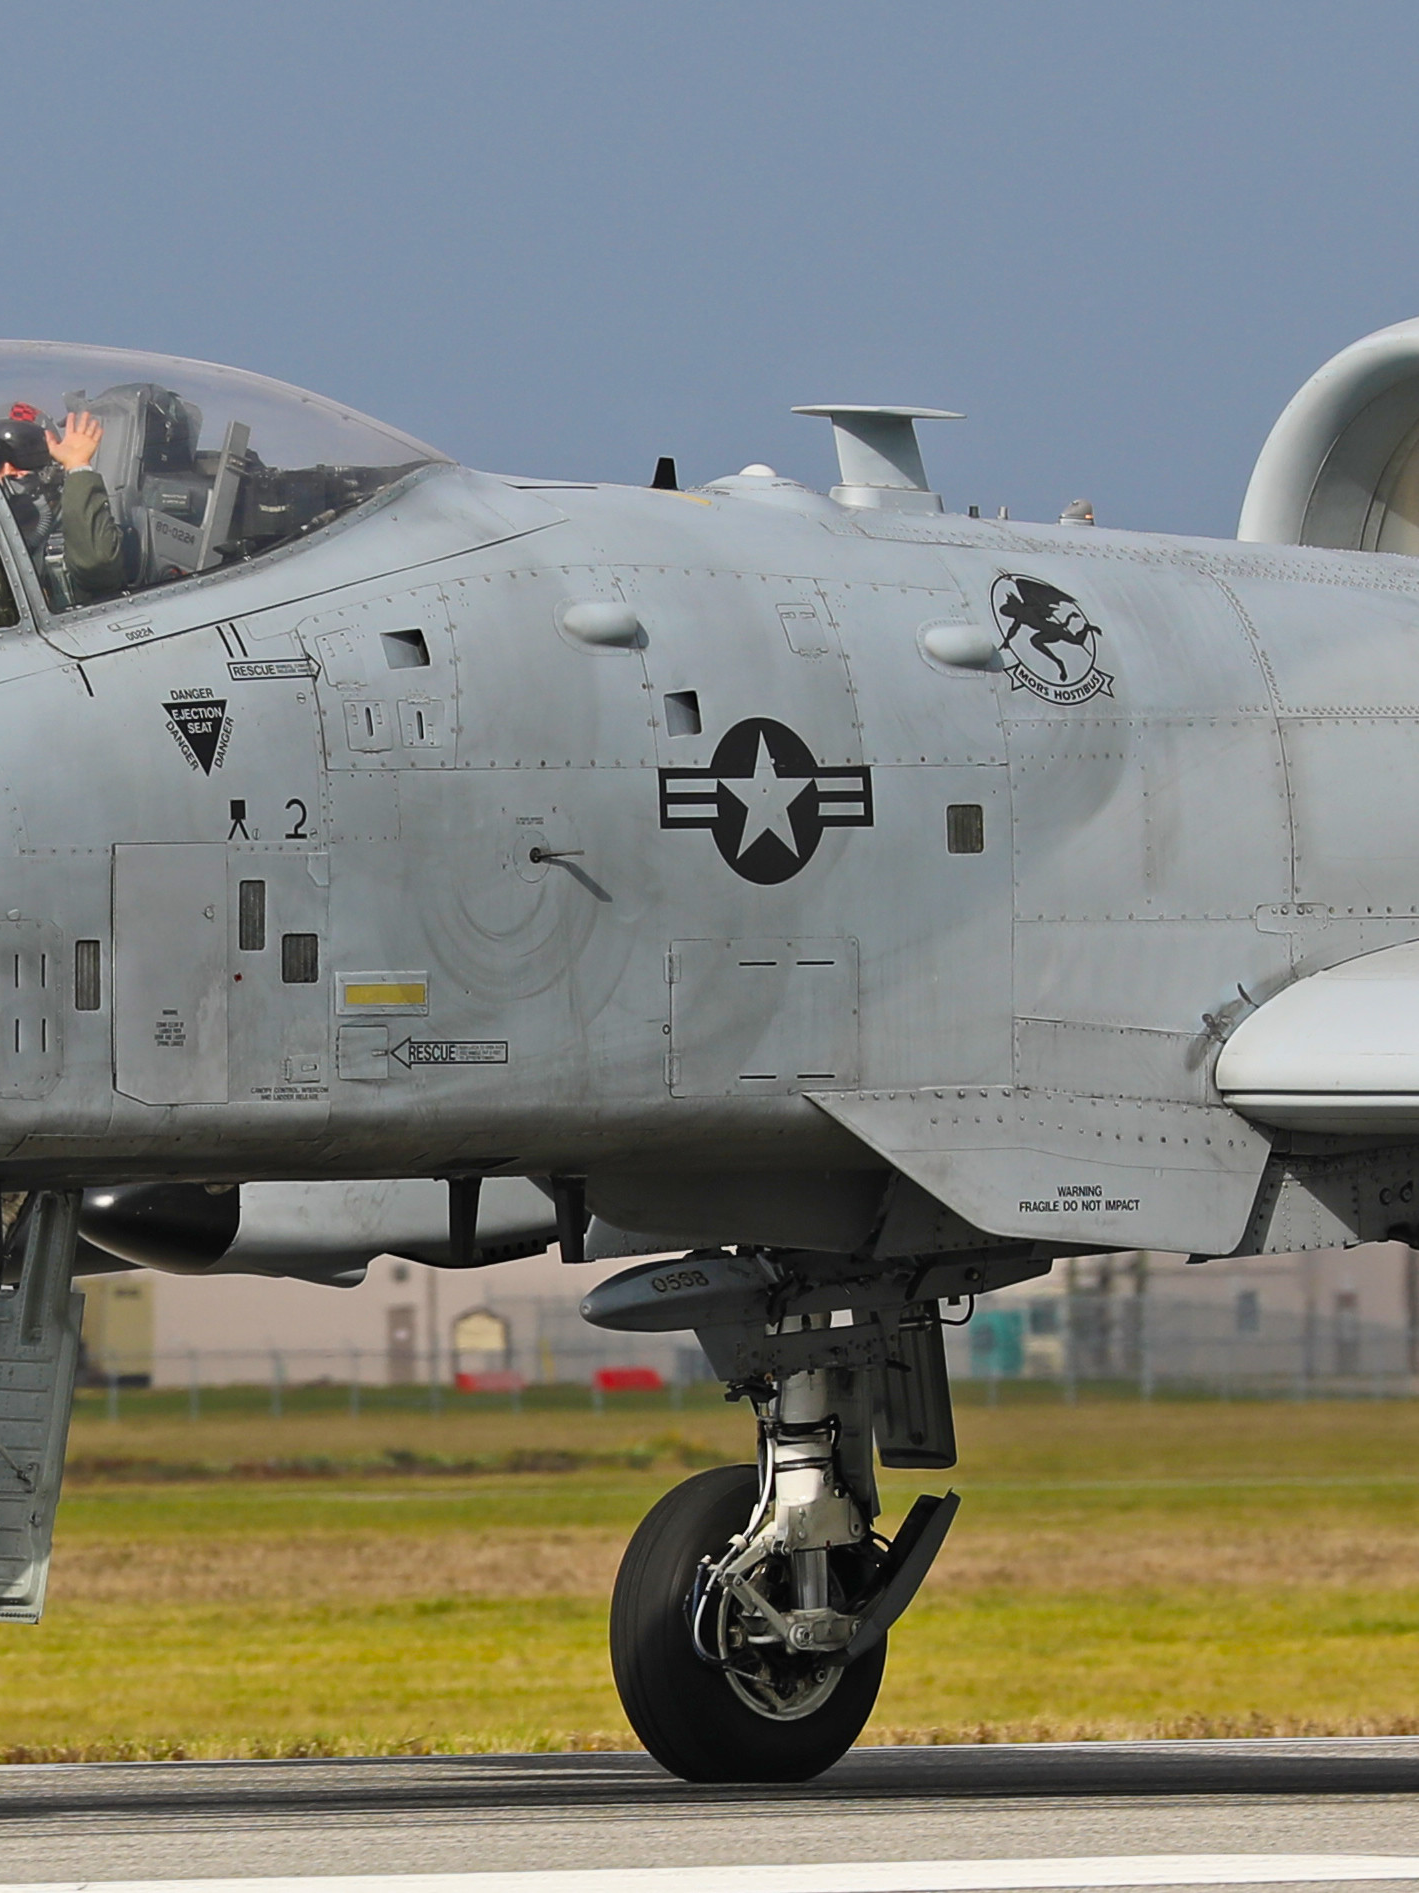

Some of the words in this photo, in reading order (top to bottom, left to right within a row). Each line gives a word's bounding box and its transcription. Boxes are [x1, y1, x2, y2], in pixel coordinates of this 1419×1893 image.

[155, 520, 196, 545] 80-0224
[232, 664, 277, 677] RESCUE
[1018, 669, 1050, 697] MORS
[1054, 674, 1100, 701] HOSTIBUS
[170, 687, 215, 701] DANGER
[171, 706, 223, 721] EJECTION
[187, 721, 213, 734] SEAT
[165, 720, 200, 771] DANGER
[214, 716, 235, 769] DANGER
[409, 1045, 456, 1061] RESCUE
[1057, 1185, 1102, 1197] WARNING
[1019, 1201, 1059, 1212] FRAGILE
[1063, 1200, 1078, 1212] DO
[1081, 1200, 1101, 1212] NOT
[1105, 1200, 1140, 1211] IMPACT
